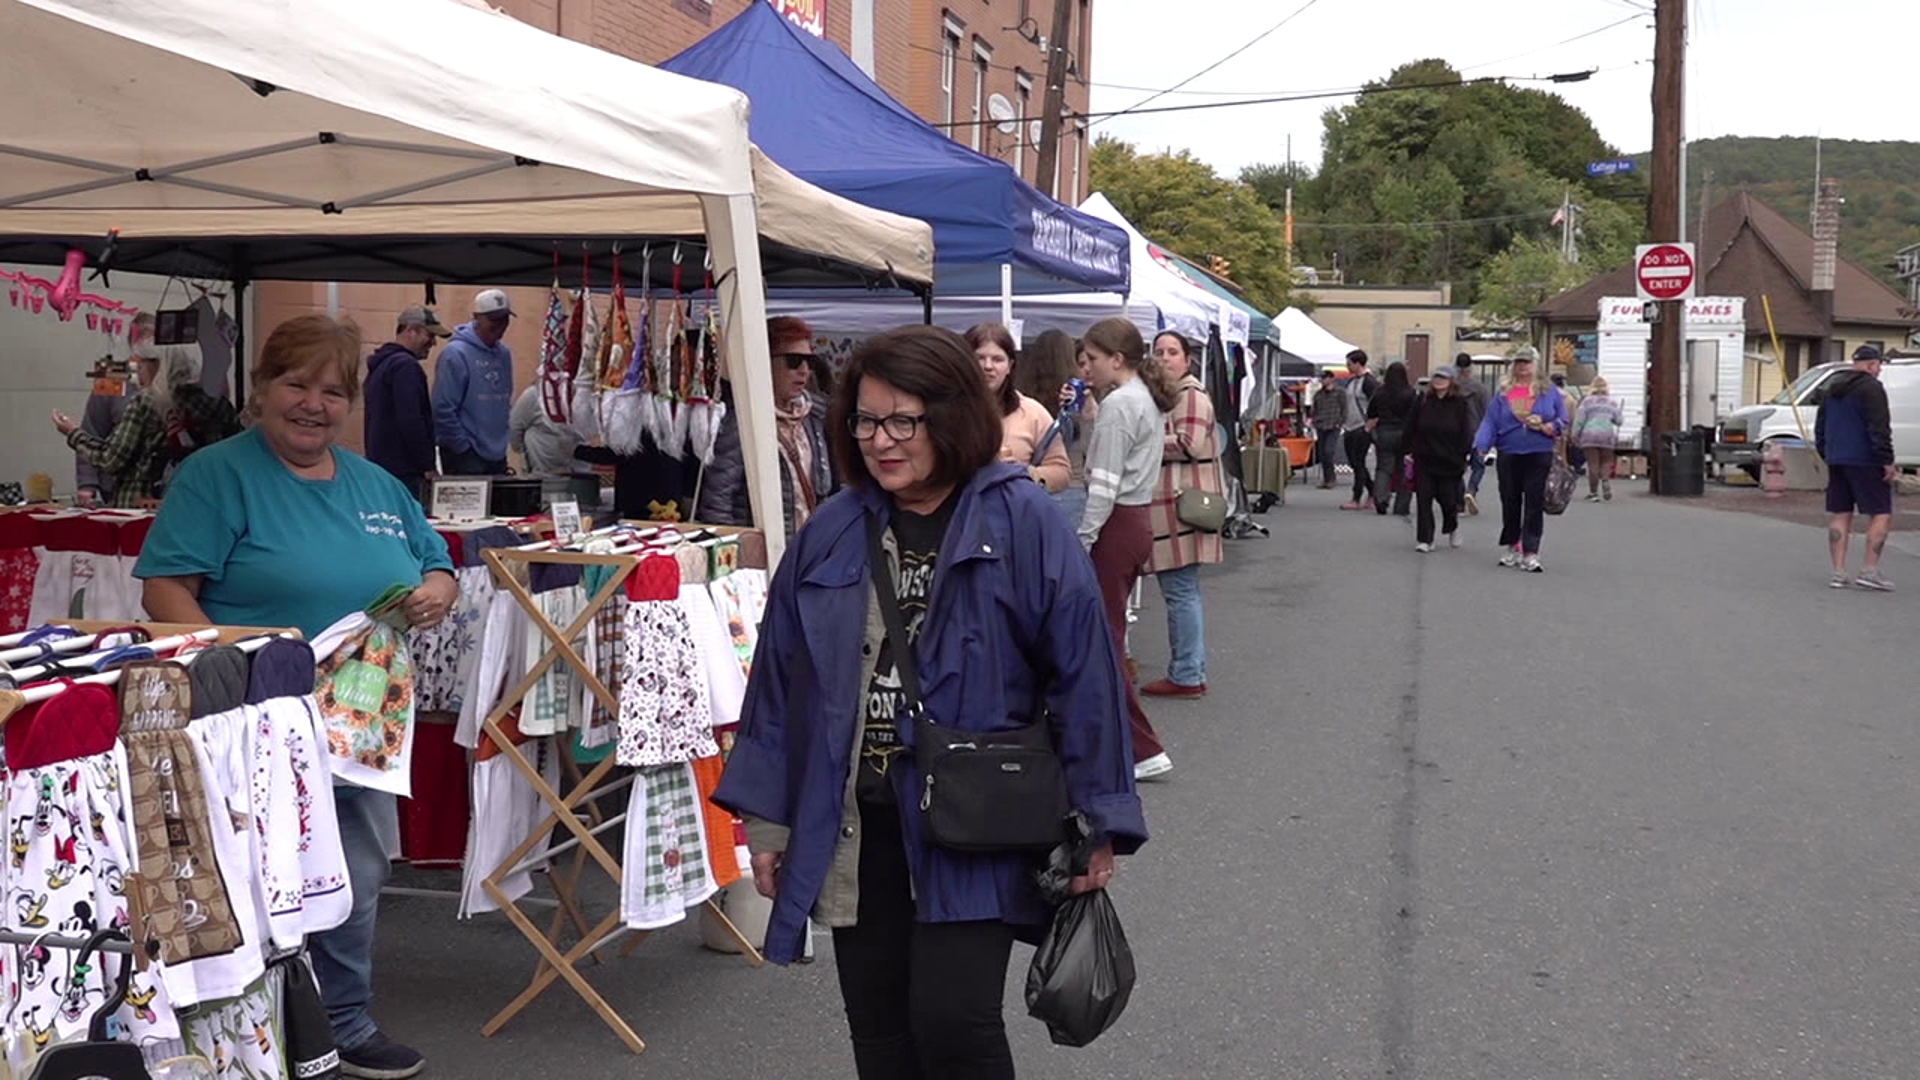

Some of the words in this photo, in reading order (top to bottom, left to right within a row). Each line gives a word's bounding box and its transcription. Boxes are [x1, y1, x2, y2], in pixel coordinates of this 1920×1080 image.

[1644, 254, 1660, 265] DO
[1664, 253, 1685, 264] NOT
[1649, 279, 1682, 290] ENTER
[1611, 305, 1644, 315] FUN
[1689, 305, 1733, 316] AKES
